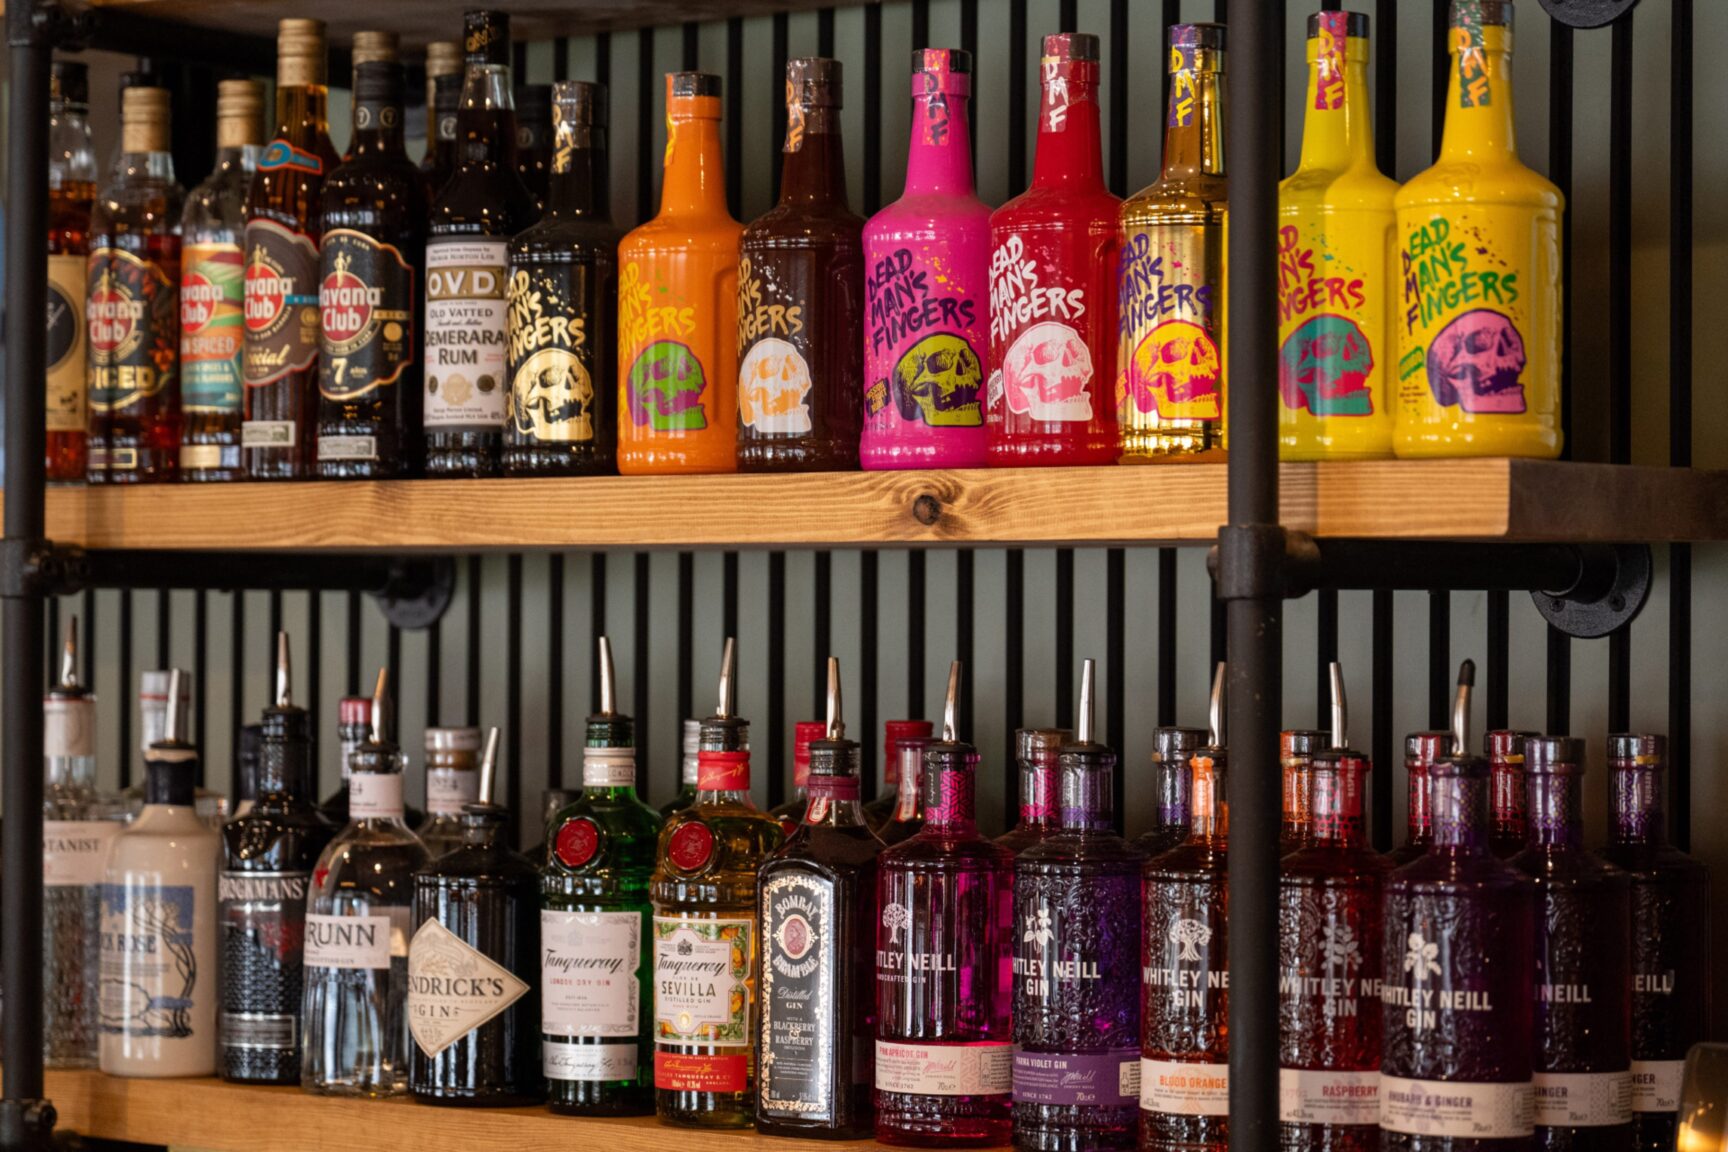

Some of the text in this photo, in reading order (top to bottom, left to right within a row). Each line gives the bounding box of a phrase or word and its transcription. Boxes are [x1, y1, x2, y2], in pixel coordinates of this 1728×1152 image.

[1401, 218, 1450, 276] DEAD
[868, 248, 912, 302] DEAD
[1405, 241, 1468, 303] MAN'S
[871, 271, 928, 326] MAN'S
[1279, 277, 1366, 328] NGERS
[1407, 272, 1518, 336] FINGERS
[323, 307, 361, 331] Club
[449, 308, 493, 318] VATTED
[990, 288, 1086, 348] FINGERS
[873, 297, 976, 356] FINGERS
[438, 348, 478, 365] RUM
[332, 357, 348, 385] 7
[43, 838, 98, 852] TANIST
[775, 895, 820, 921] BOMBAY
[305, 921, 376, 949] RUNN
[545, 948, 624, 975] Tanqueray
[658, 953, 727, 977] Tanqueray
[772, 954, 819, 978] BRAMBLE
[910, 953, 956, 971] NEILL
[1013, 957, 1101, 979] HITLEY NEILL
[408, 976, 504, 997] NDRICK'S
[1026, 979, 1049, 996] GIN
[1143, 967, 1200, 988] WHITLEY
[1634, 975, 1672, 993] EILL
[661, 981, 716, 997] SEVILLA
[778, 986, 814, 1001] Distilled
[1174, 990, 1203, 1007] GIN
[1541, 984, 1592, 1003] NEILL
[1440, 990, 1493, 1011] NEILL
[418, 1004, 450, 1018] GIN
[1406, 1009, 1436, 1029] GIN
[773, 1021, 816, 1032] BLACKBERRY
[775, 1035, 813, 1046] RASPBERRY
[1030, 1058, 1052, 1069] VIOLET
[1054, 1060, 1068, 1069] GIN
[1159, 1075, 1227, 1089] BLOOD ORANGE
[1632, 1074, 1656, 1085] NGER
[1322, 1086, 1378, 1098] RASPBERRY
[1424, 1096, 1432, 1107] &
[1434, 1095, 1472, 1108] GINGER
